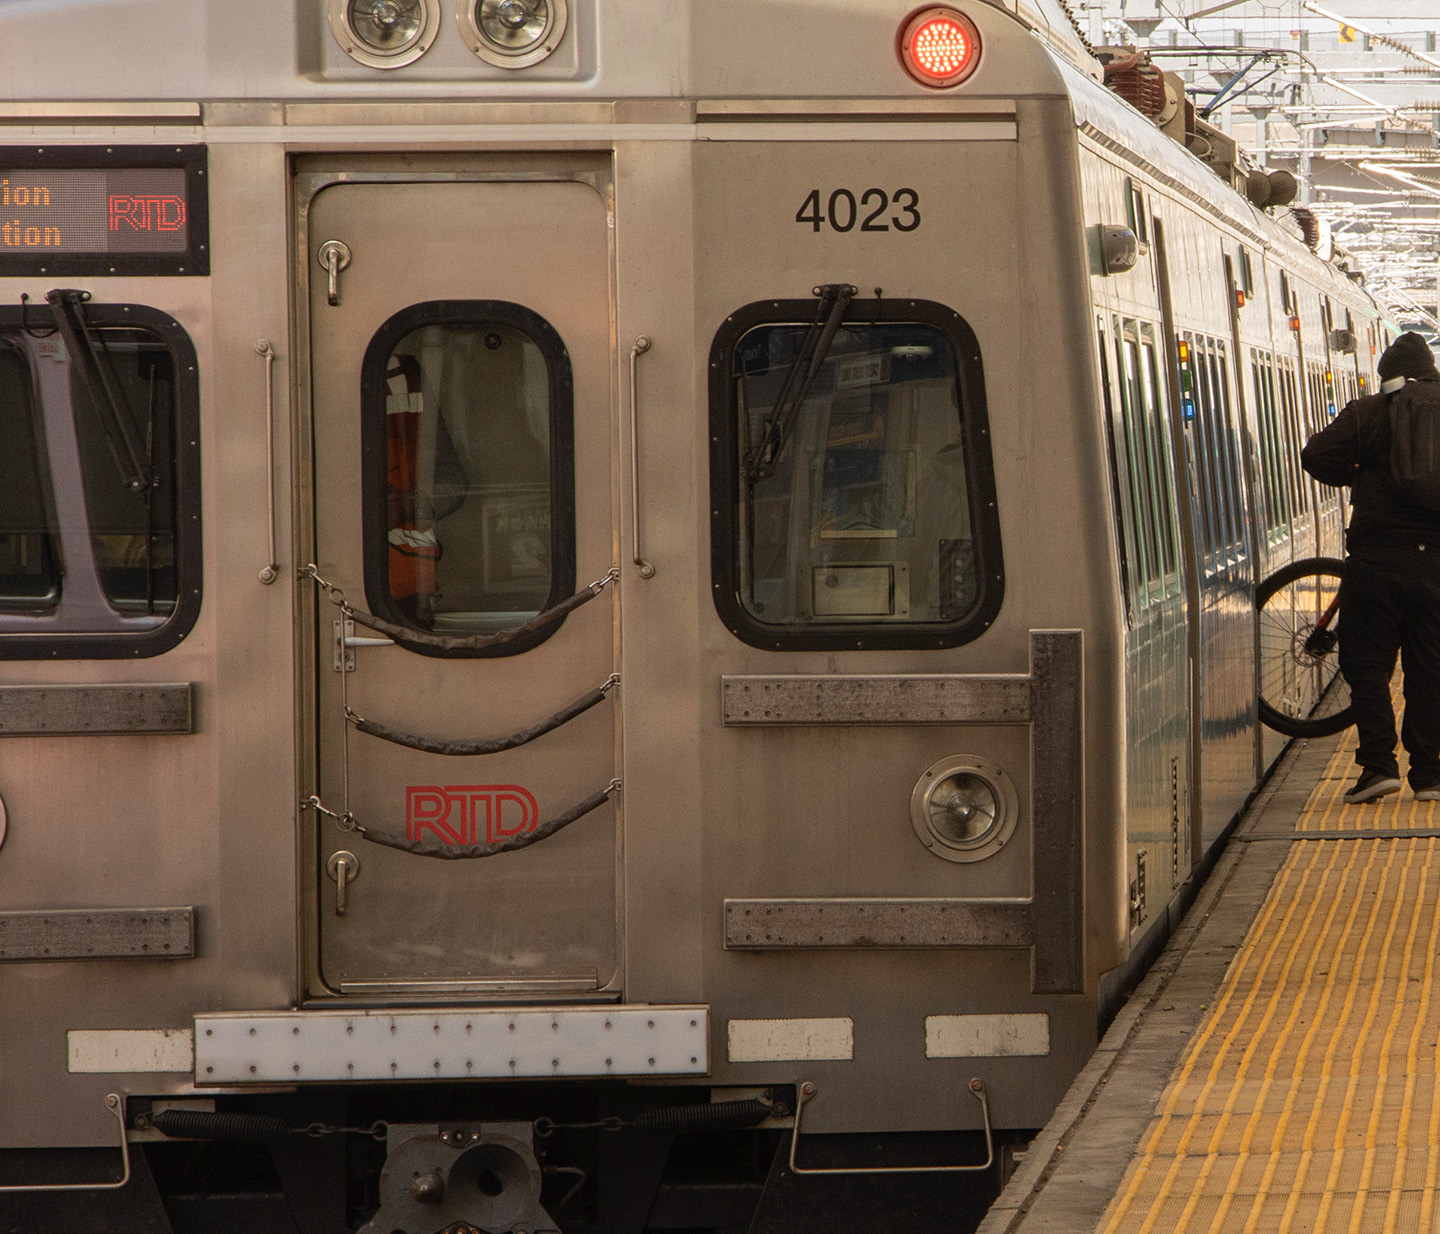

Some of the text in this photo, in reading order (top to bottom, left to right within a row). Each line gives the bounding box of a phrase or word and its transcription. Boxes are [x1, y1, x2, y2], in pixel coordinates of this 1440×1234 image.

[109, 195, 187, 231] RTD
[795, 187, 921, 233] 4023
[1, 219, 61, 246] tion
[406, 784, 539, 846] RTD
